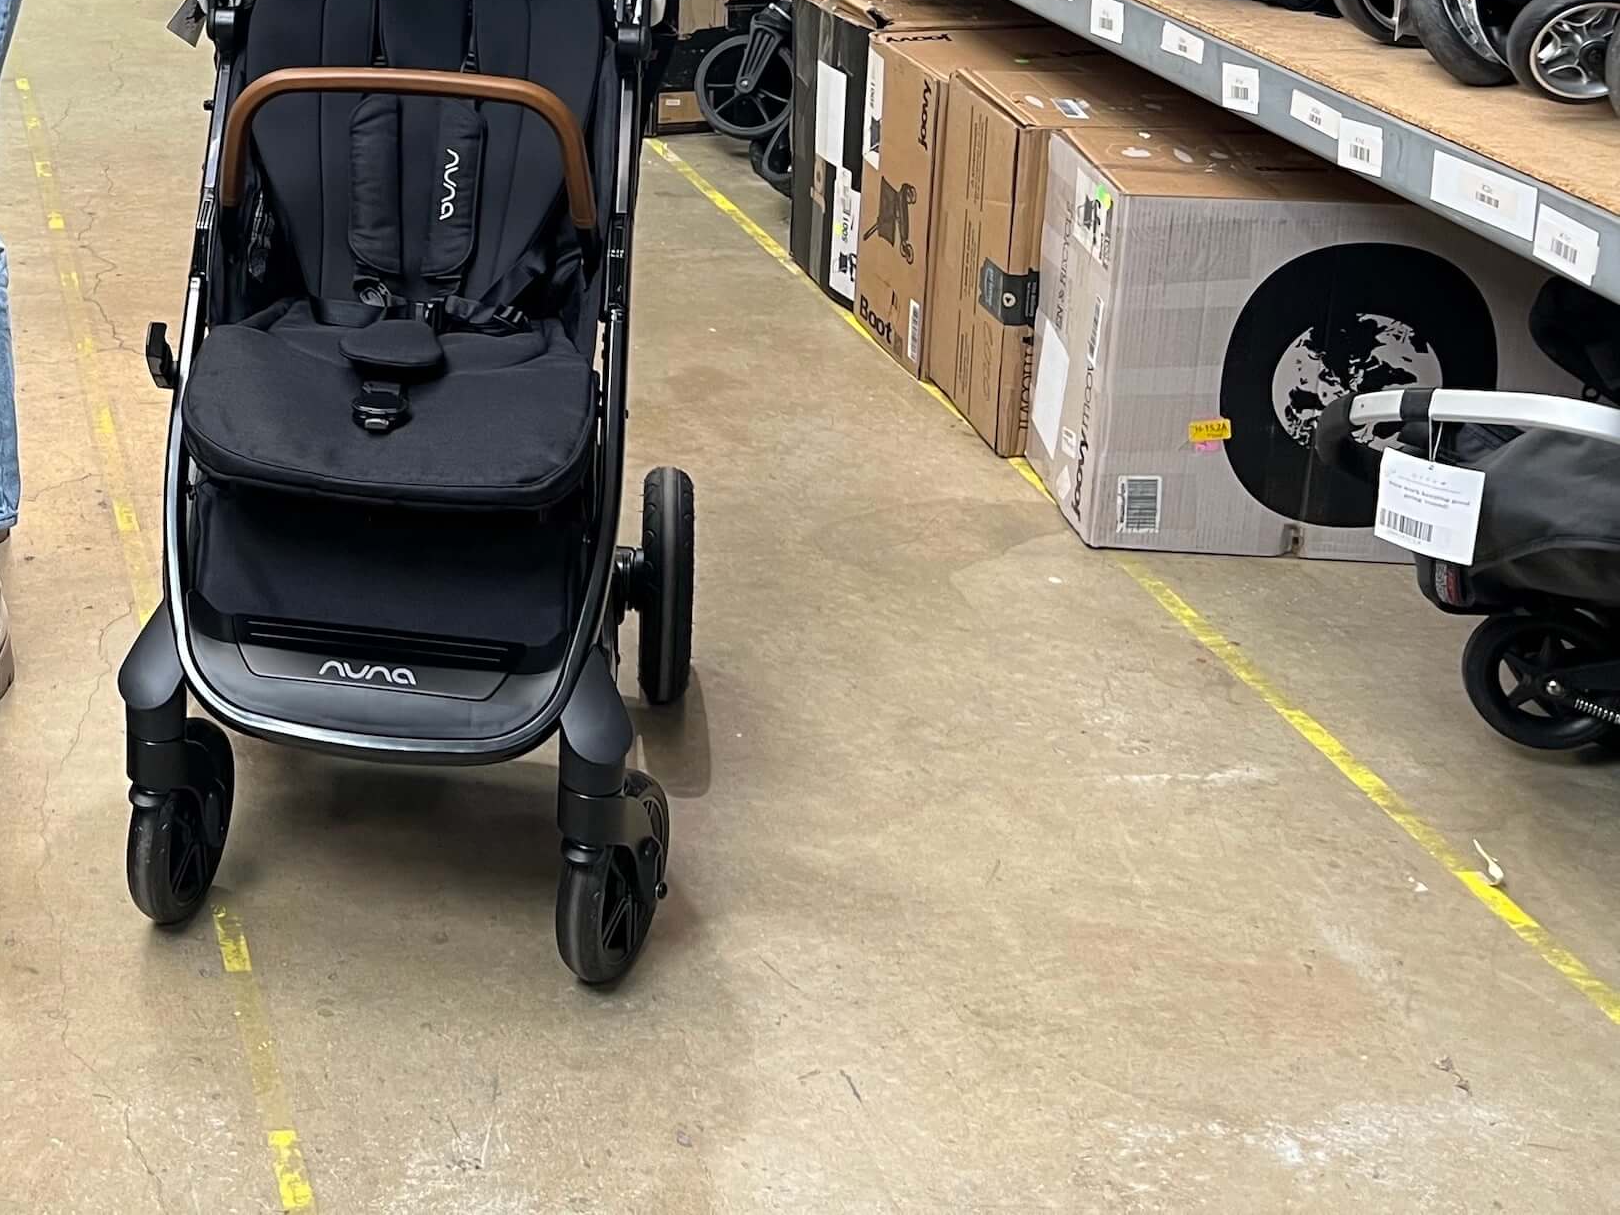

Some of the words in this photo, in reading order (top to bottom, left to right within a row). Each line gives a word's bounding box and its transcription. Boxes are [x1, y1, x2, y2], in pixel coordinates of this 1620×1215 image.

[917, 79, 932, 151] joovy
[439, 147, 461, 222] nuna
[860, 295, 893, 344] Boot
[1070, 430, 1090, 521] joovy
[317, 659, 418, 688] nuna
